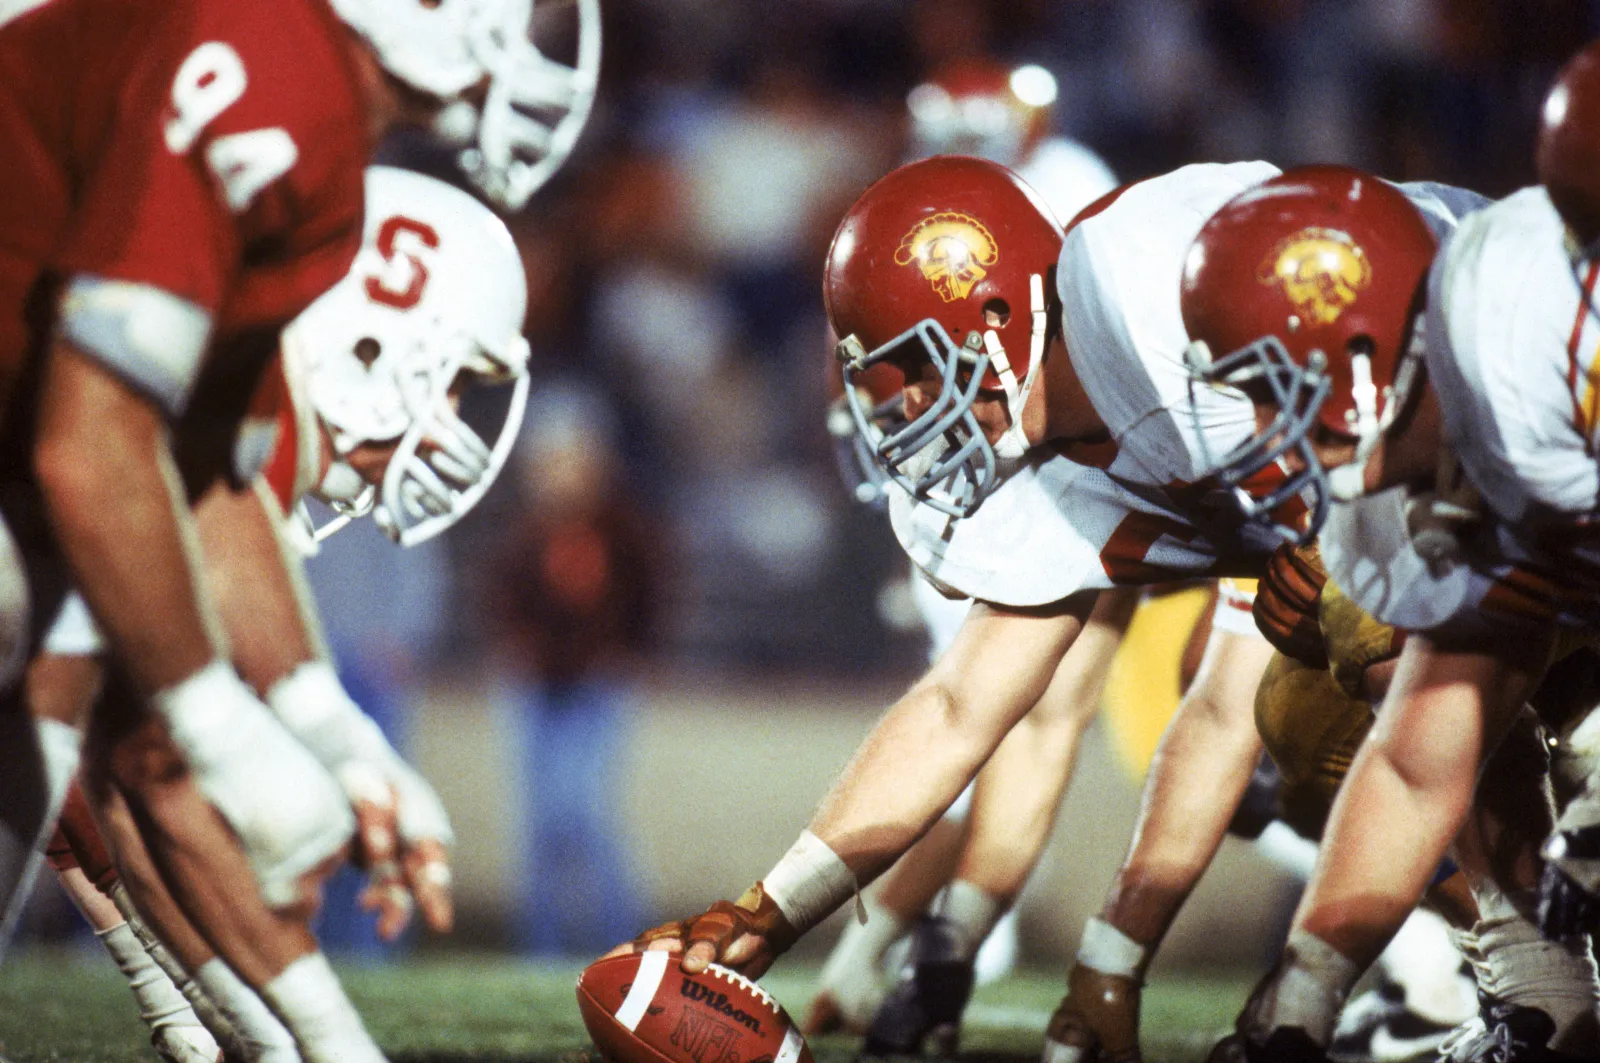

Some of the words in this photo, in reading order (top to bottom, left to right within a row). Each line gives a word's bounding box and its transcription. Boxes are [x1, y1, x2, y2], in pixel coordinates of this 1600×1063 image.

[364, 215, 440, 311] S
[669, 1004, 743, 1063] NFL
[680, 978, 760, 1033] Wilson
